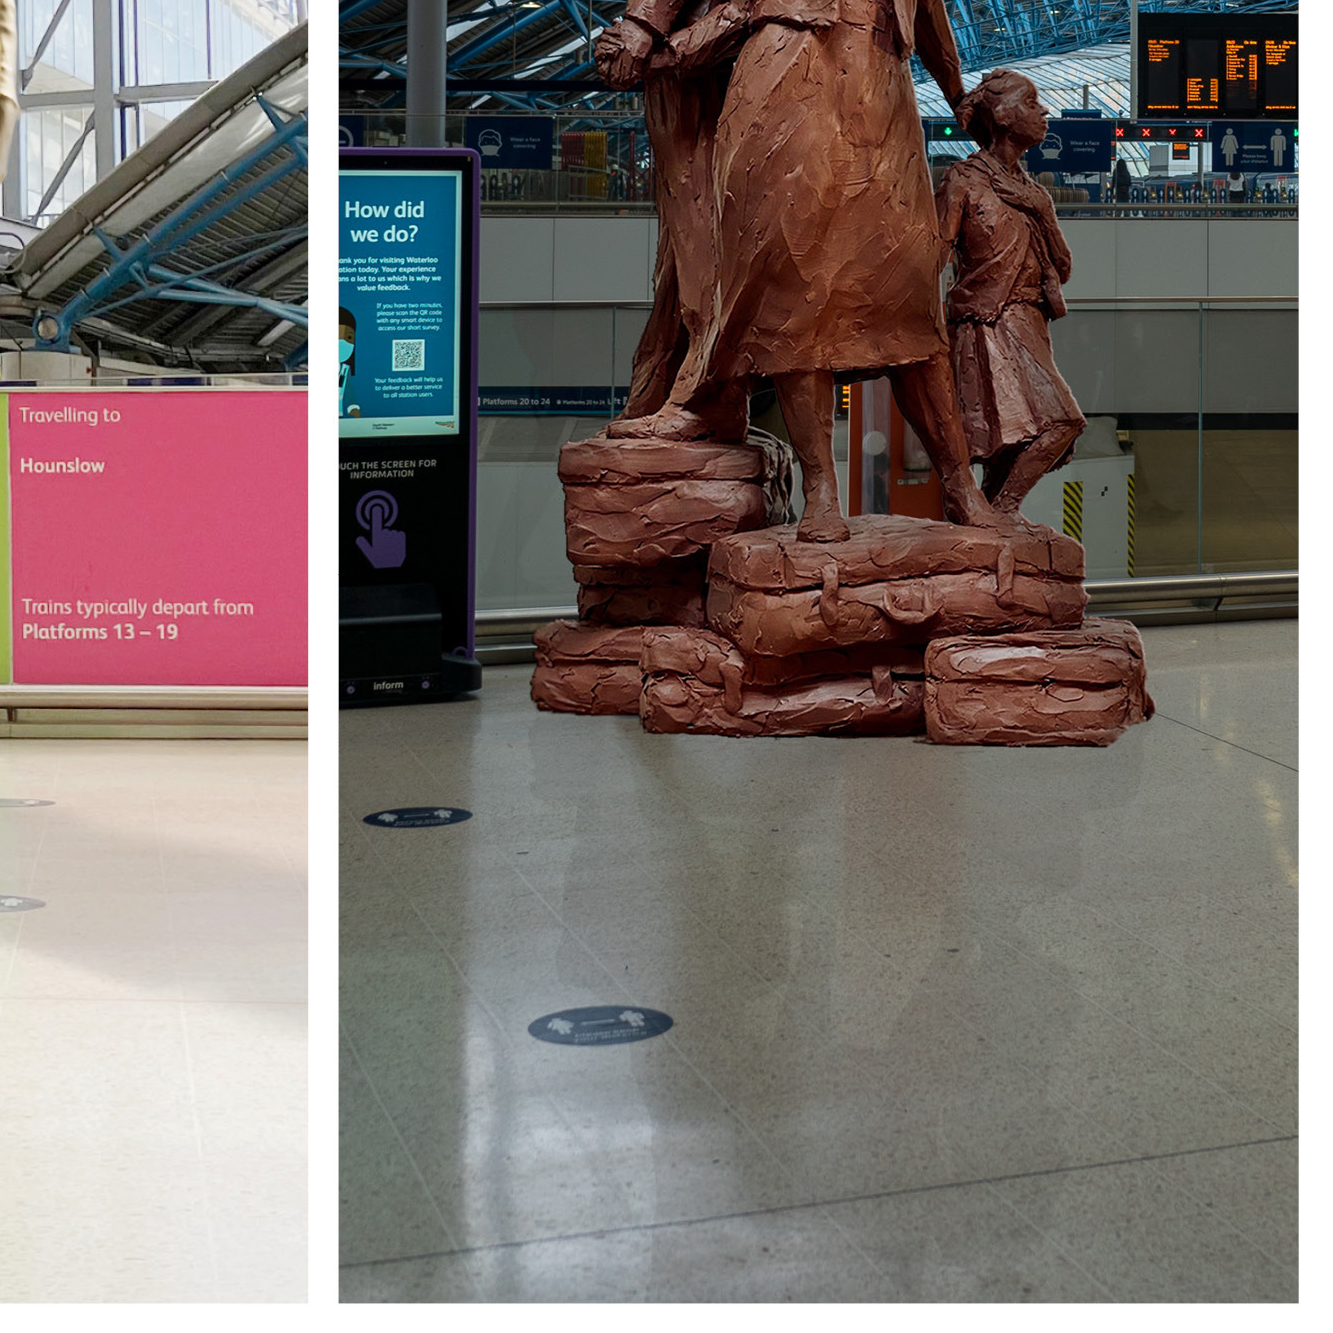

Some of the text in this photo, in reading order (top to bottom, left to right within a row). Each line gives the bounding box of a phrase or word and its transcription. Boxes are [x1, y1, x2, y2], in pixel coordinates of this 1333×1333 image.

[345, 200, 425, 218] How did
[350, 224, 418, 243] we do?
[353, 258, 367, 266] you
[379, 257, 405, 265] visiting
[406, 256, 438, 264] Waterloo
[358, 266, 380, 274] today.
[398, 266, 437, 274] experience
[416, 275, 430, 283] why
[423, 376, 436, 384] help
[483, 398, 518, 406] Platforms
[519, 398, 529, 406] 20
[530, 398, 539, 406] to
[19, 406, 121, 426] Travelling to
[20, 457, 105, 473] Hounslow
[339, 459, 437, 470] UCH THE SCREEN FOR
[350, 469, 414, 479] INFORMATION
[21, 597, 254, 619] Trains typically depart from
[22, 623, 108, 639] Platforms
[113, 623, 135, 639] 13
[156, 623, 178, 639] 19
[373, 681, 404, 690] inform
